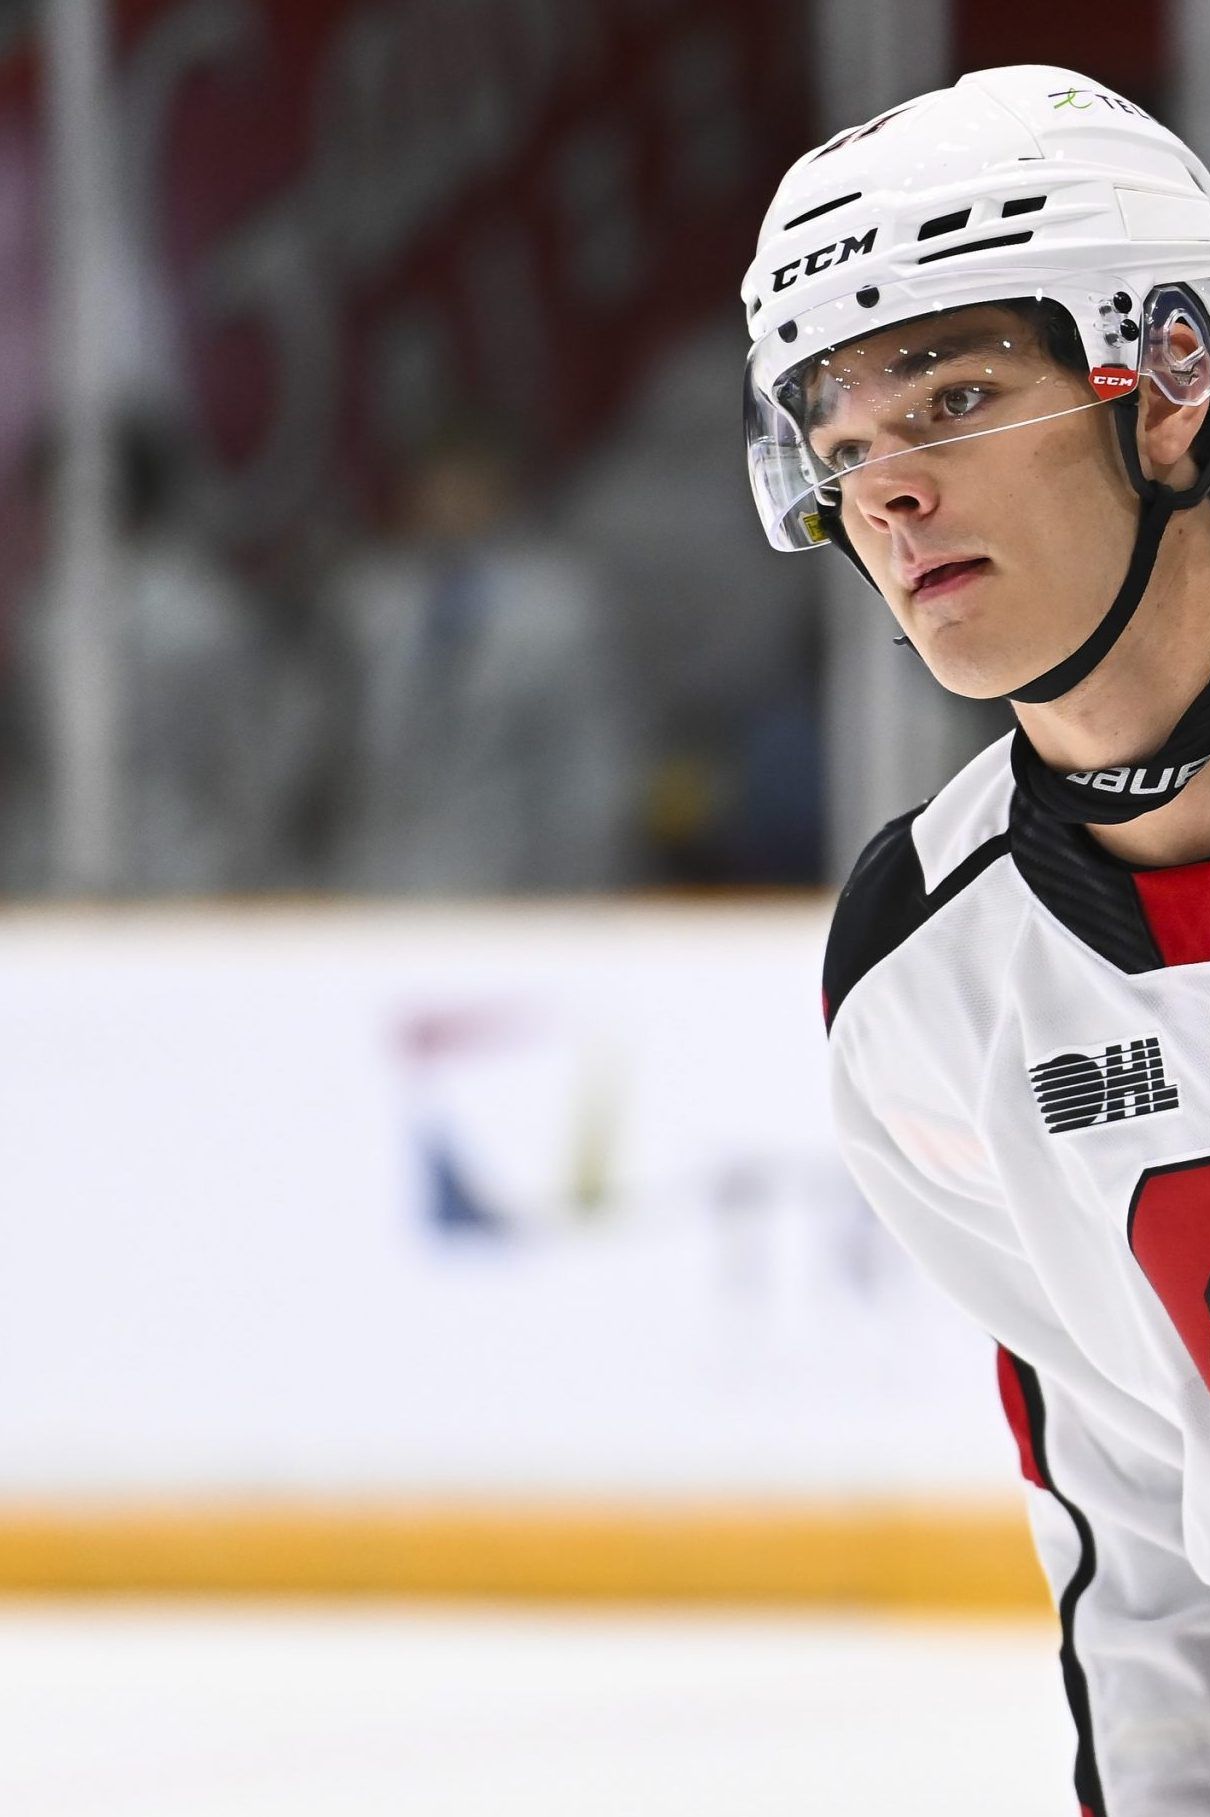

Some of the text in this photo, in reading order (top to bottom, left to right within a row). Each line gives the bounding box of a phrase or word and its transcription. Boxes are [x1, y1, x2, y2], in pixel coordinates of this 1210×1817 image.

[1095, 93, 1151, 120] TEL
[771, 227, 879, 293] CCM
[1093, 376, 1134, 387] CCM
[1029, 1037, 1179, 1134] OHL
